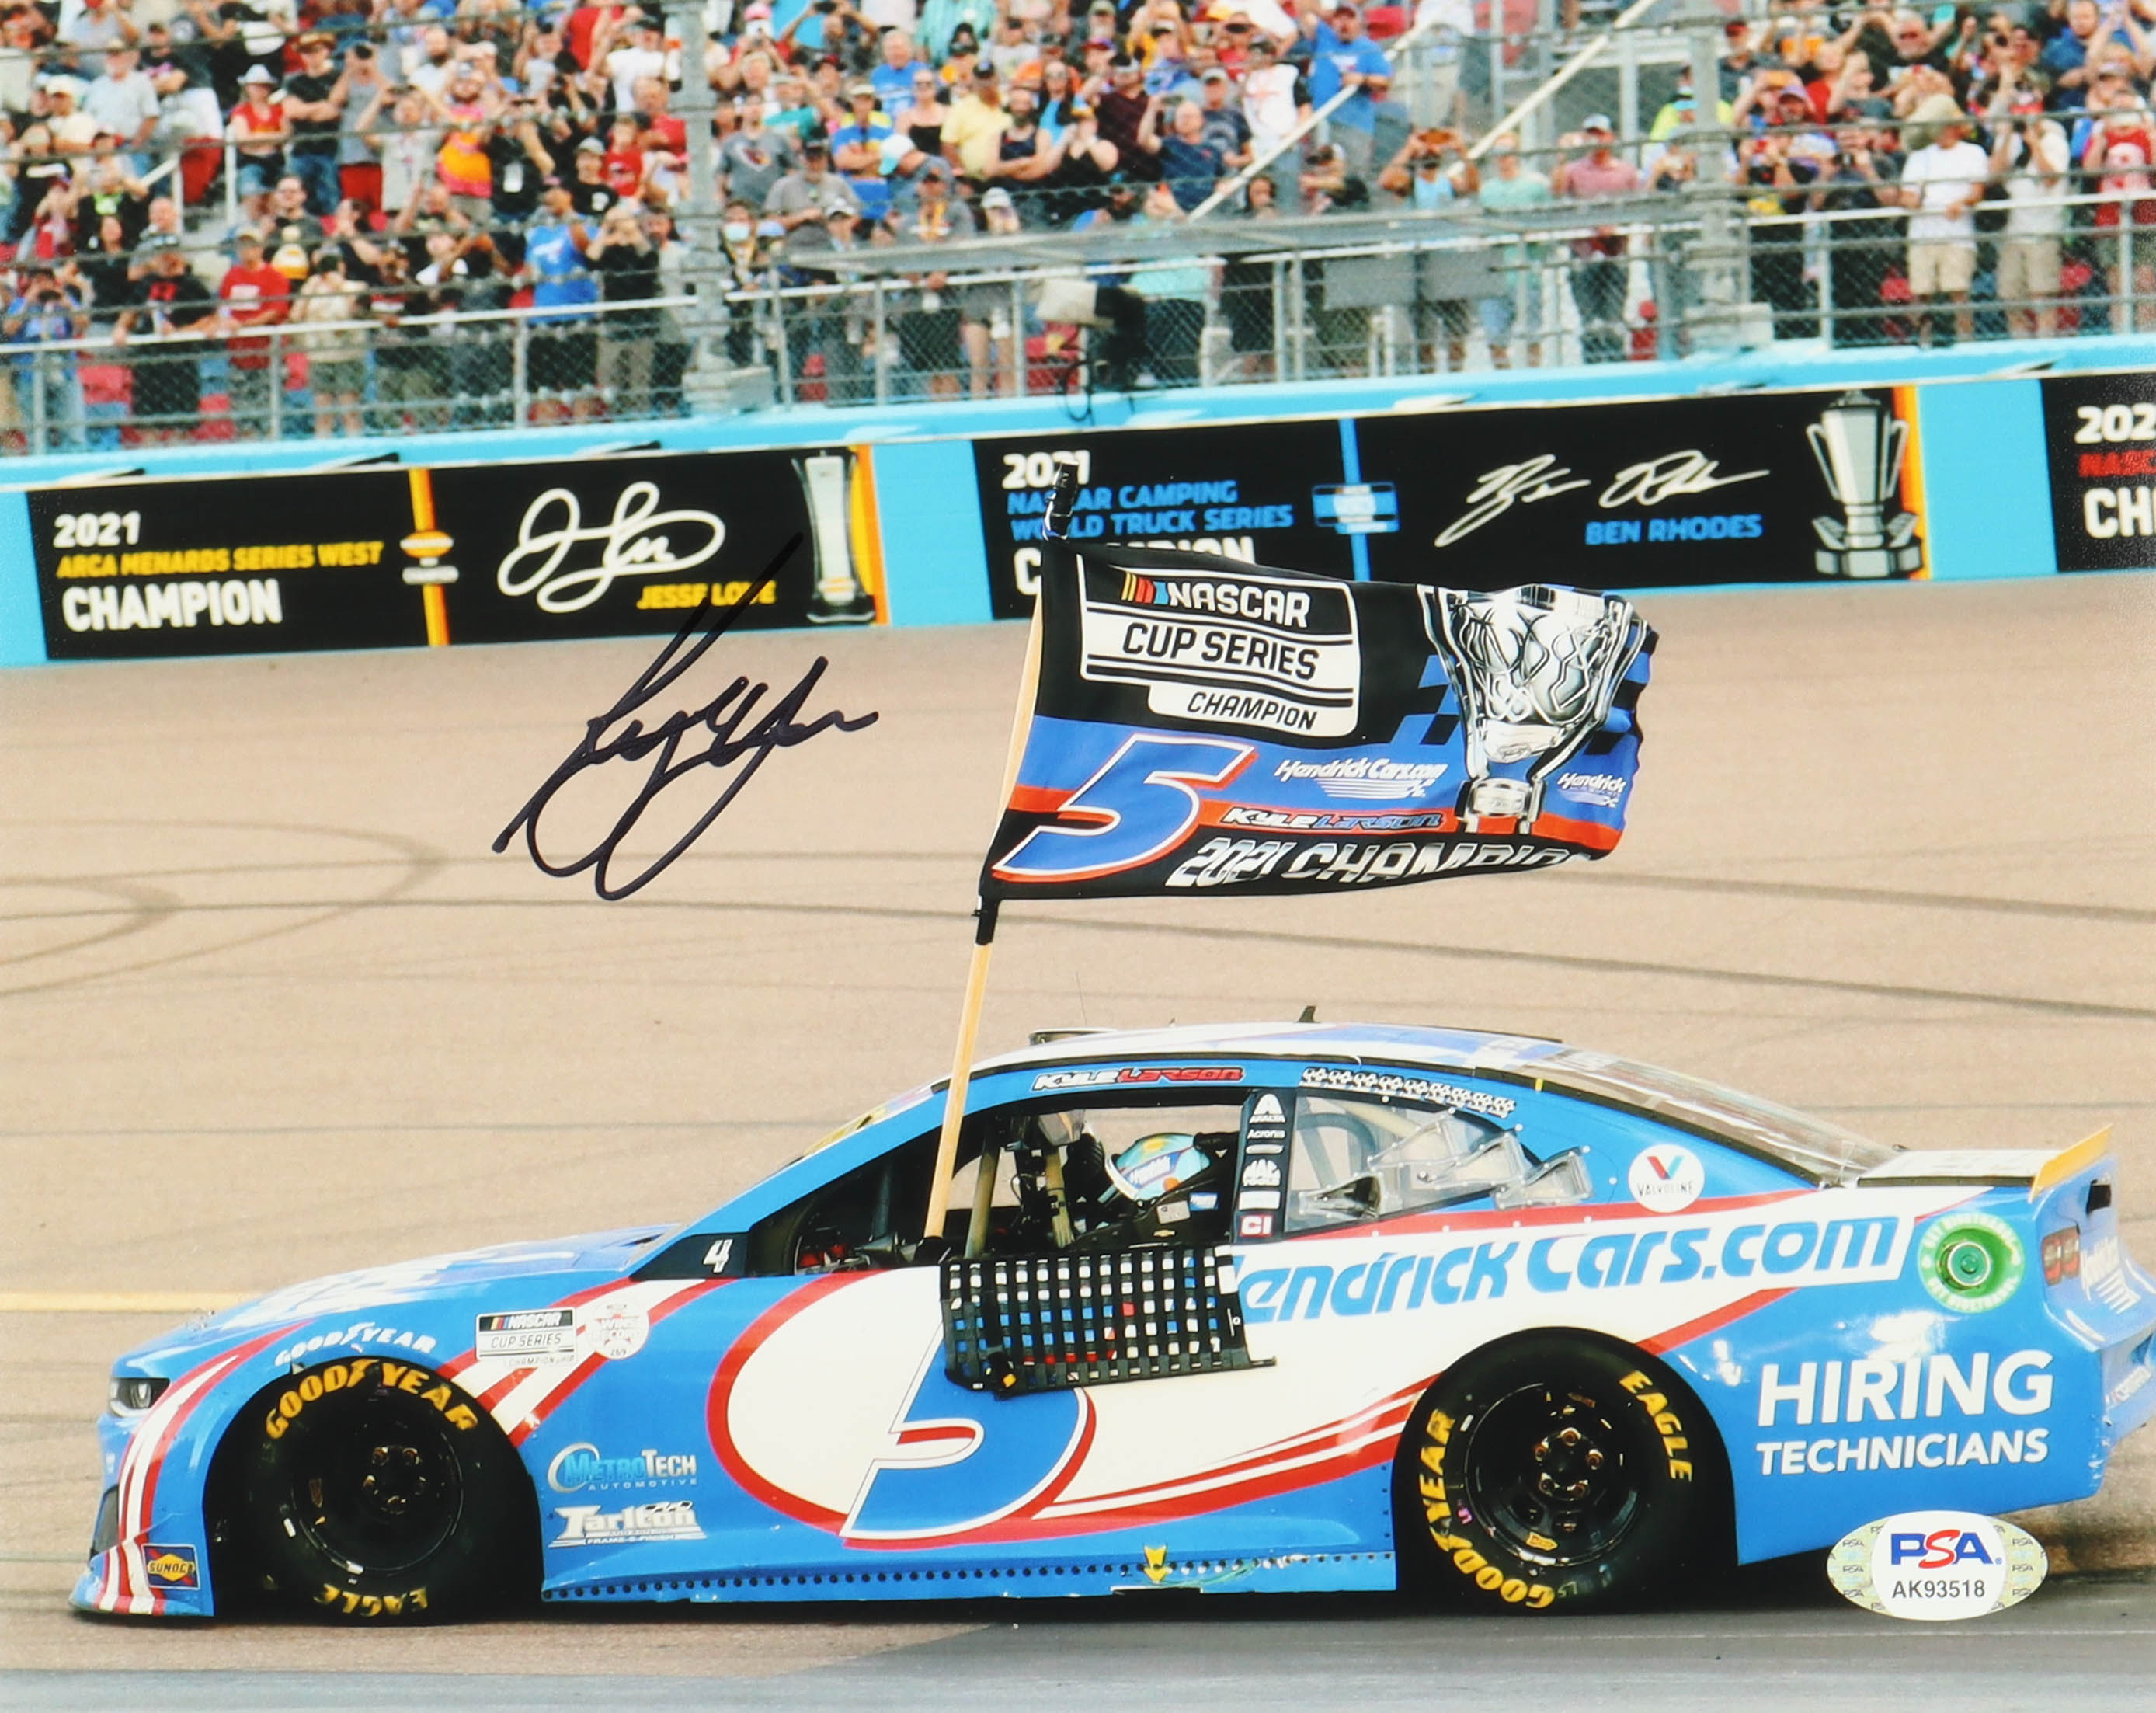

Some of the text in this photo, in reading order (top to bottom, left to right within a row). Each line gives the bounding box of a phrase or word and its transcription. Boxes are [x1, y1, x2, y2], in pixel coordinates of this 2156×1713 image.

[2074, 402, 2156, 444] 202
[1008, 480, 1238, 514] NAAR CAMPING
[53, 511, 141, 548] 2021
[1010, 503, 1294, 541] WLD TRUCK SERIES
[1585, 514, 1763, 545] BEN RHODES
[56, 541, 384, 579] ARCA MENARDS SERIES WEST
[61, 578, 283, 632] CHAMPION
[1168, 582, 1311, 628] NASCAR
[1122, 622, 1320, 681] CUP SERIES
[1187, 691, 1318, 730] CHAMPION
[992, 733, 1259, 883] 5
[703, 1239, 733, 1273] 4
[1233, 1216, 1900, 1325] endrickCars.com
[491, 1333, 562, 1348] CUP SERIES
[509, 1312, 562, 1330] NASCAR
[1758, 1350, 2053, 1426] HIRING
[1619, 1370, 1694, 1482] EAGLE
[1756, 1429, 2050, 1475] TECHNICIANS
[588, 1479, 697, 1491] AUTOMOTIVE
